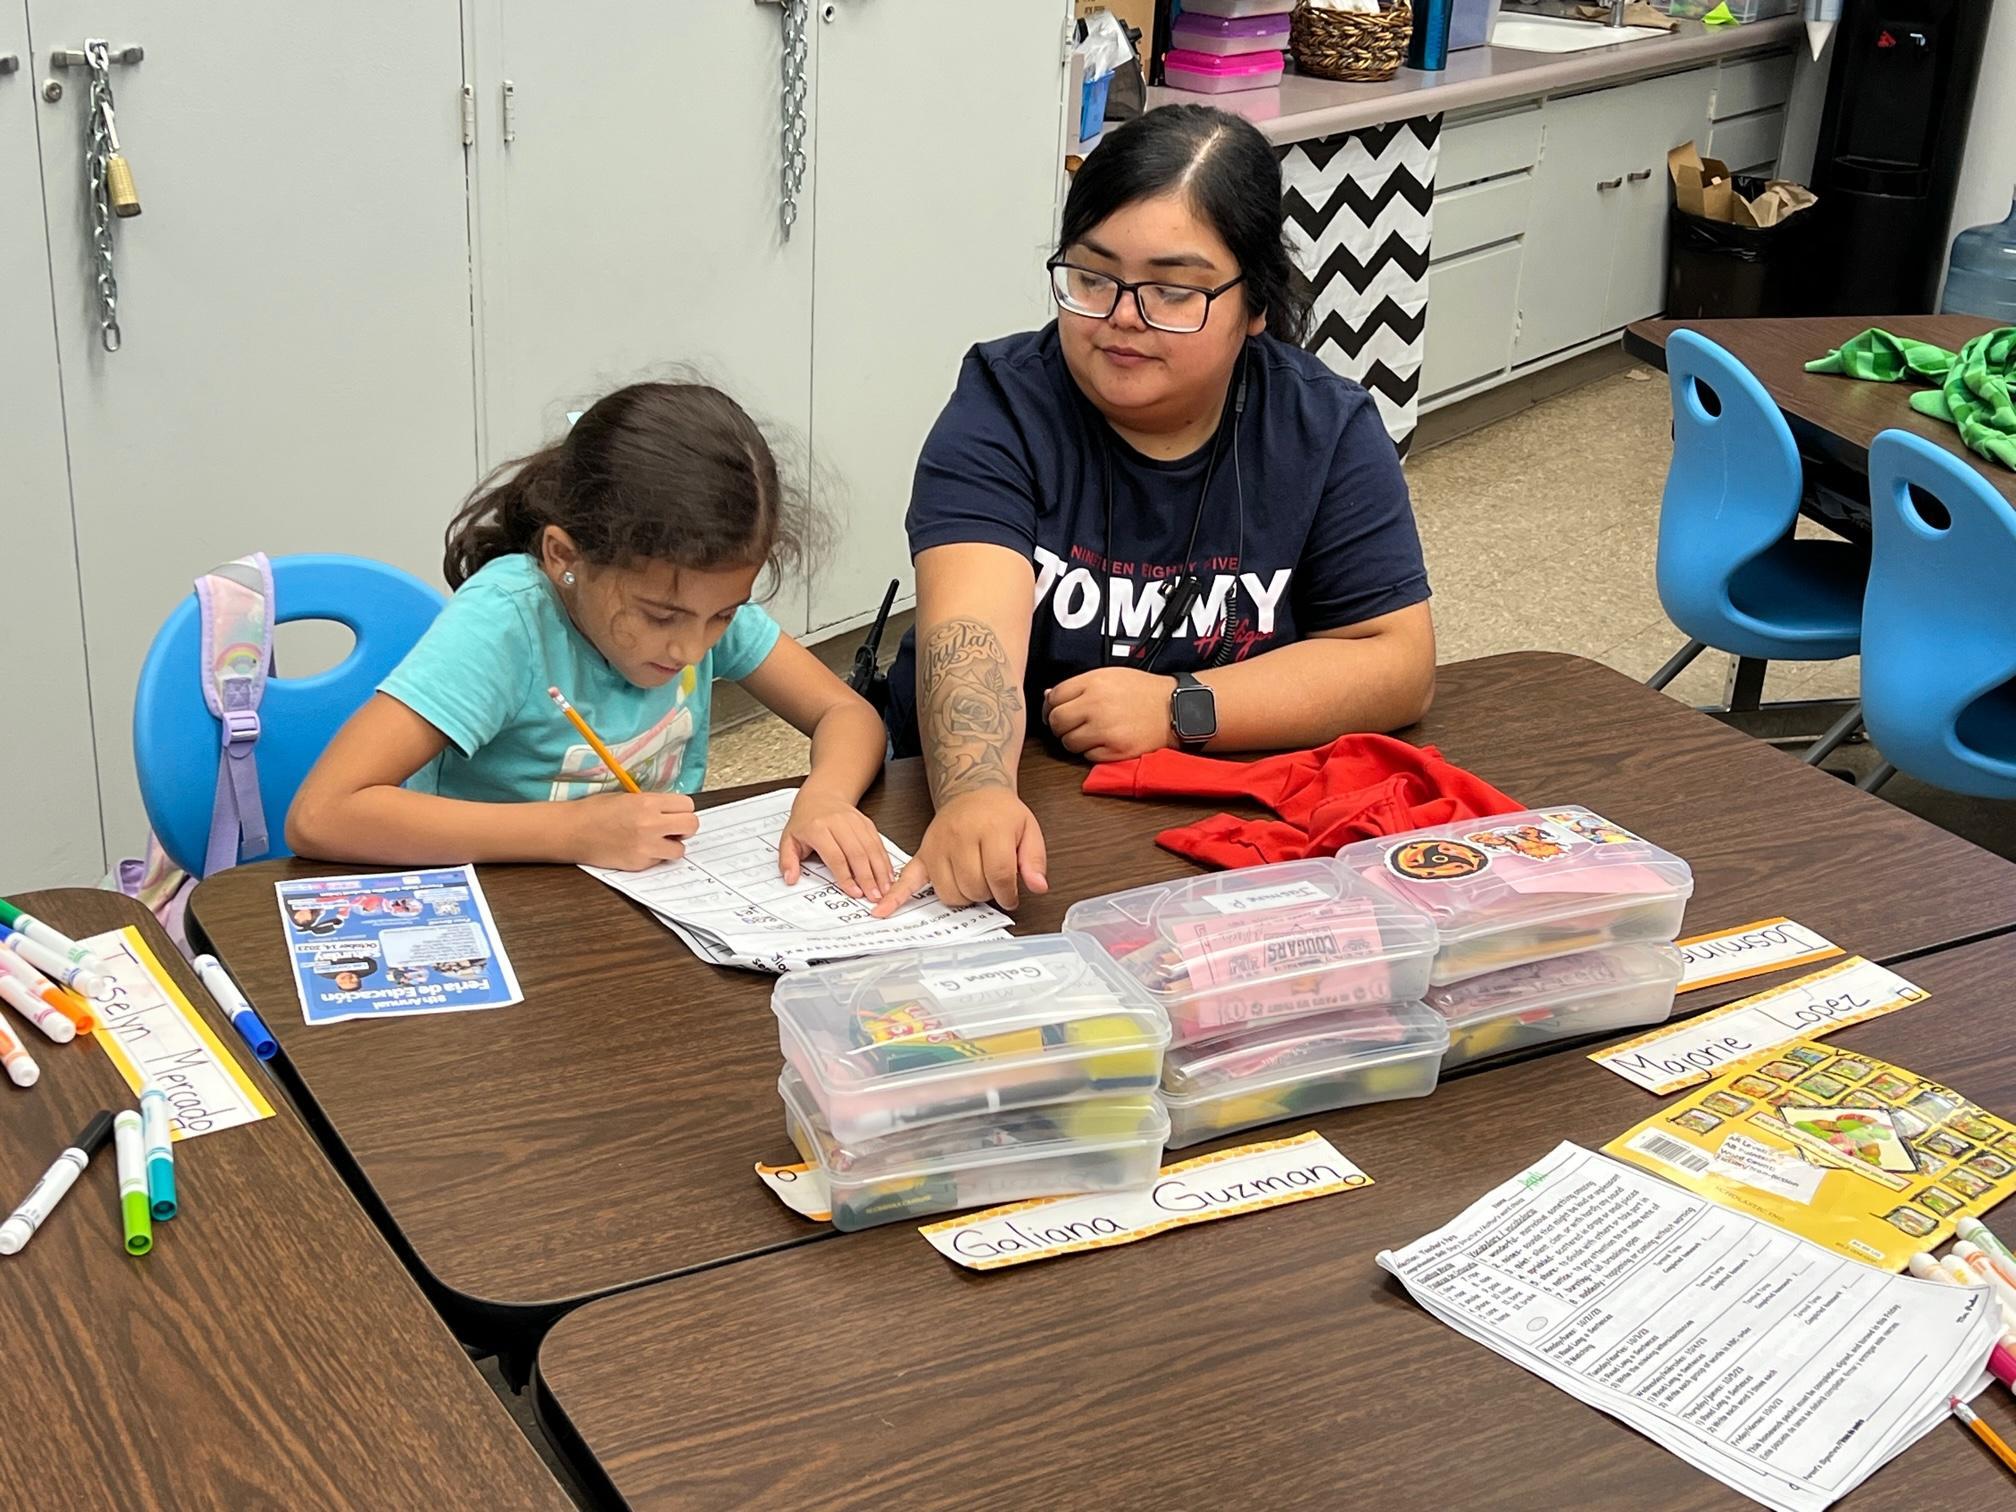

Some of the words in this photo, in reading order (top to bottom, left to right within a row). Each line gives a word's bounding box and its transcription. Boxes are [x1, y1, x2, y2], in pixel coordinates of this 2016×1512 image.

[803, 886, 839, 902] bed
[825, 897, 857, 913] leg
[337, 941, 379, 951] October
[1267, 932, 1339, 965] COUGARS
[316, 950, 382, 963] Saturday
[320, 984, 417, 1003] Educación
[416, 981, 441, 997] de
[443, 978, 491, 995] Feria
[372, 996, 421, 1011] Annual
[1611, 1034, 1753, 1081] Majorie
[1753, 990, 1872, 1031] Lopez
[145, 1048, 238, 1132] Mercado
[953, 1216, 1129, 1260] Galiana
[1151, 1162, 1343, 1213] Guzman
[1489, 1237, 1518, 1257] wonderful-
[1547, 1194, 1577, 1215] something
[1523, 1234, 1543, 1249] sounds
[1540, 1224, 1555, 1235] that
[1553, 1212, 1570, 1225] might
[1566, 1249, 1585, 1262] divide
[1582, 1239, 1596, 1249] with
[1595, 1224, 1614, 1240] others
[1617, 1212, 1632, 1220] take
[1630, 1202, 1643, 1213] part
[1570, 1217, 1584, 1227] with
[1555, 1233, 1583, 1255] scattered
[1587, 1217, 1604, 1230] drops
[1579, 1280, 1605, 1298] suddenly-
[1603, 1259, 1635, 1279] happening
[1655, 1224, 1674, 1239] without
[1673, 1207, 1696, 1224] warning
[1580, 1258, 1593, 1268] pay
[1590, 1240, 1616, 1259] attention
[1564, 1275, 1592, 1292] bursting-
[1602, 1247, 1629, 1264] breaking
[1625, 1236, 1640, 1247] open
[1587, 1314, 1613, 1333] Sentences
[1569, 1344, 1595, 1362] Matching
[1633, 1336, 1659, 1355] Sentences
[1680, 1354, 1706, 1373] Sentences
[1728, 1375, 1753, 1396] Sentences
[1758, 1421, 1783, 1443] homework
